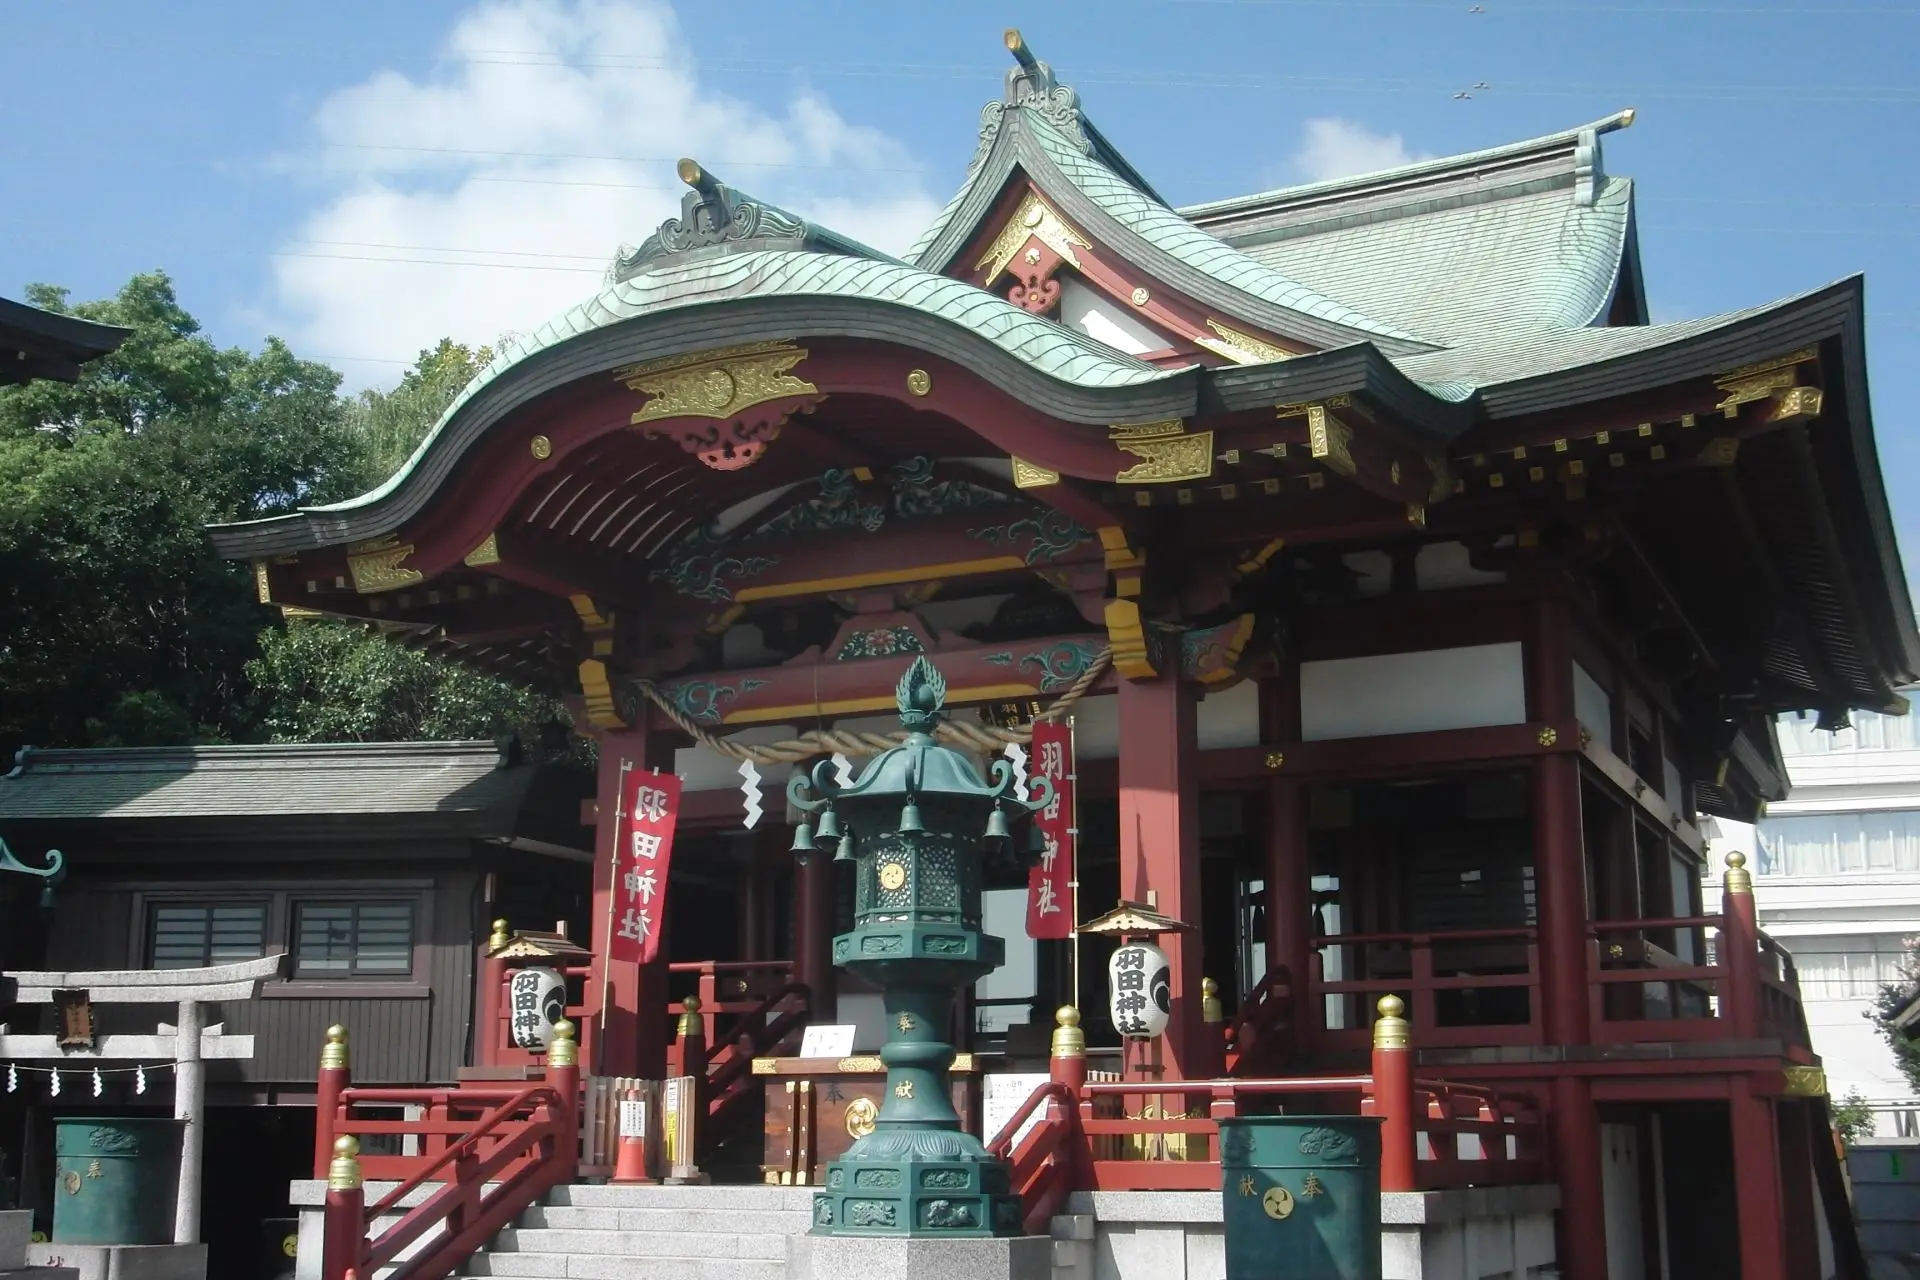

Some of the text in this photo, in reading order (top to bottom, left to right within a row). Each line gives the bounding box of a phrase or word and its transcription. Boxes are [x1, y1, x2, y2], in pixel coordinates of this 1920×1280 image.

[514, 973, 544, 1048] 羽田神社
[1115, 948, 1150, 1034] 羽田神社
